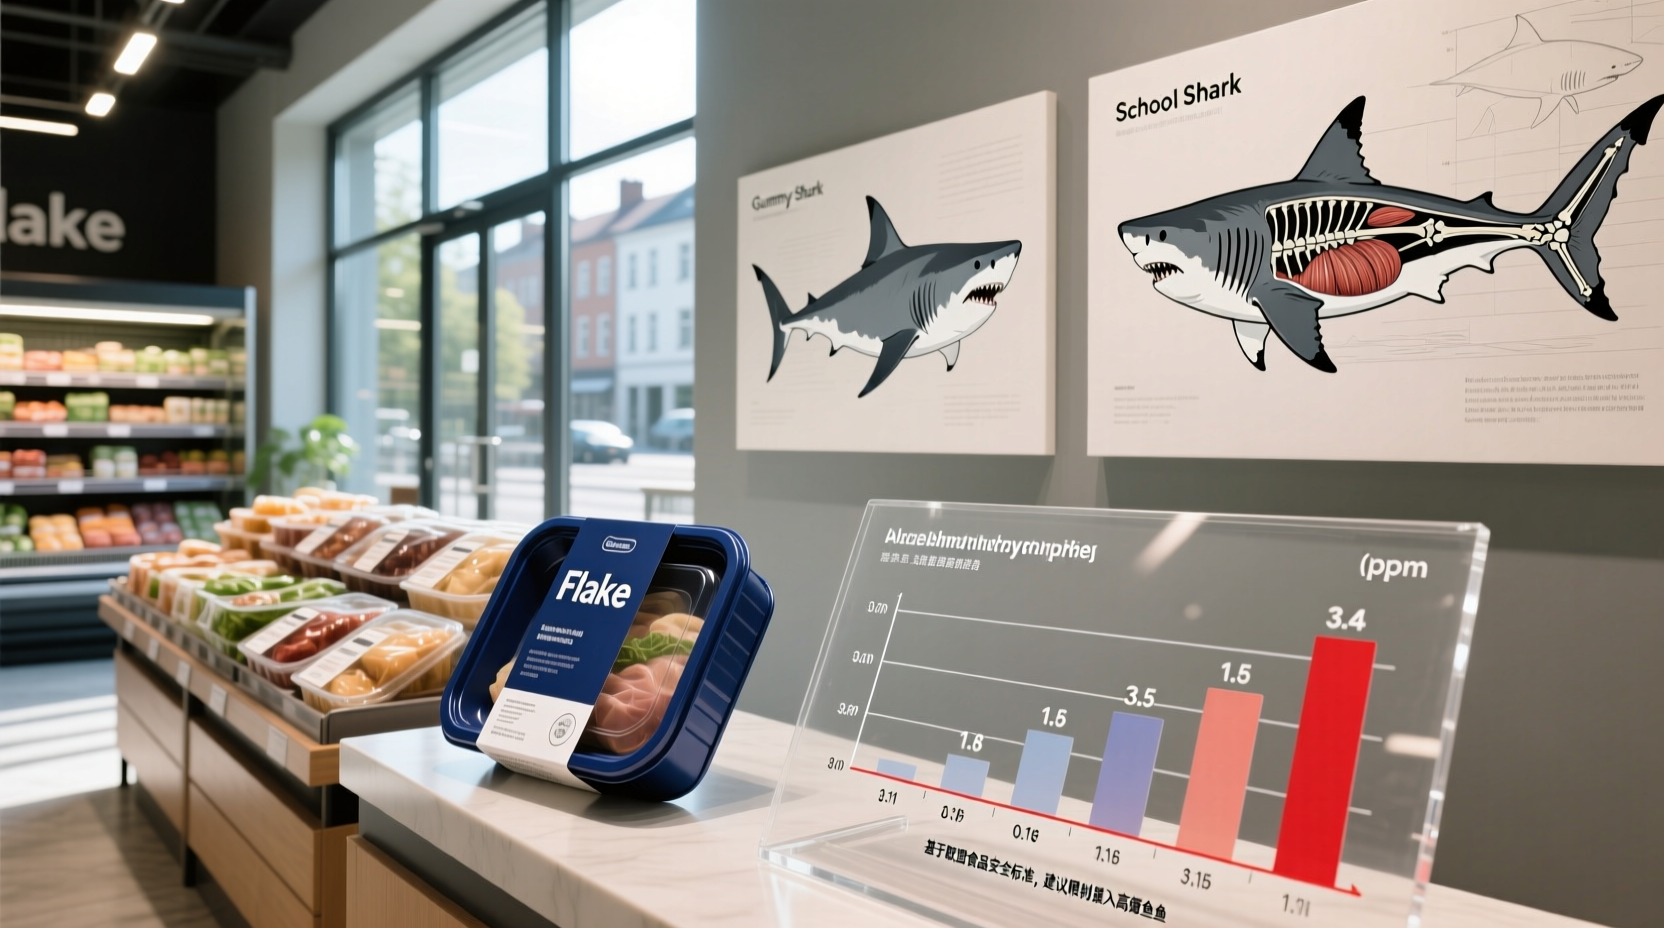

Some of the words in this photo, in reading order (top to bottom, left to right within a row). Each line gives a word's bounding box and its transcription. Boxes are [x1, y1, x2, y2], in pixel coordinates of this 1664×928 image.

[1115, 88, 1178, 122] School
[1183, 72, 1242, 105] Shark
[1359, 552, 1428, 582] (ppm
[556, 569, 632, 609] Flake
[1325, 605, 1367, 632] 3.4
[1220, 661, 1252, 685] 1.5
[1123, 685, 1157, 708] 3.5
